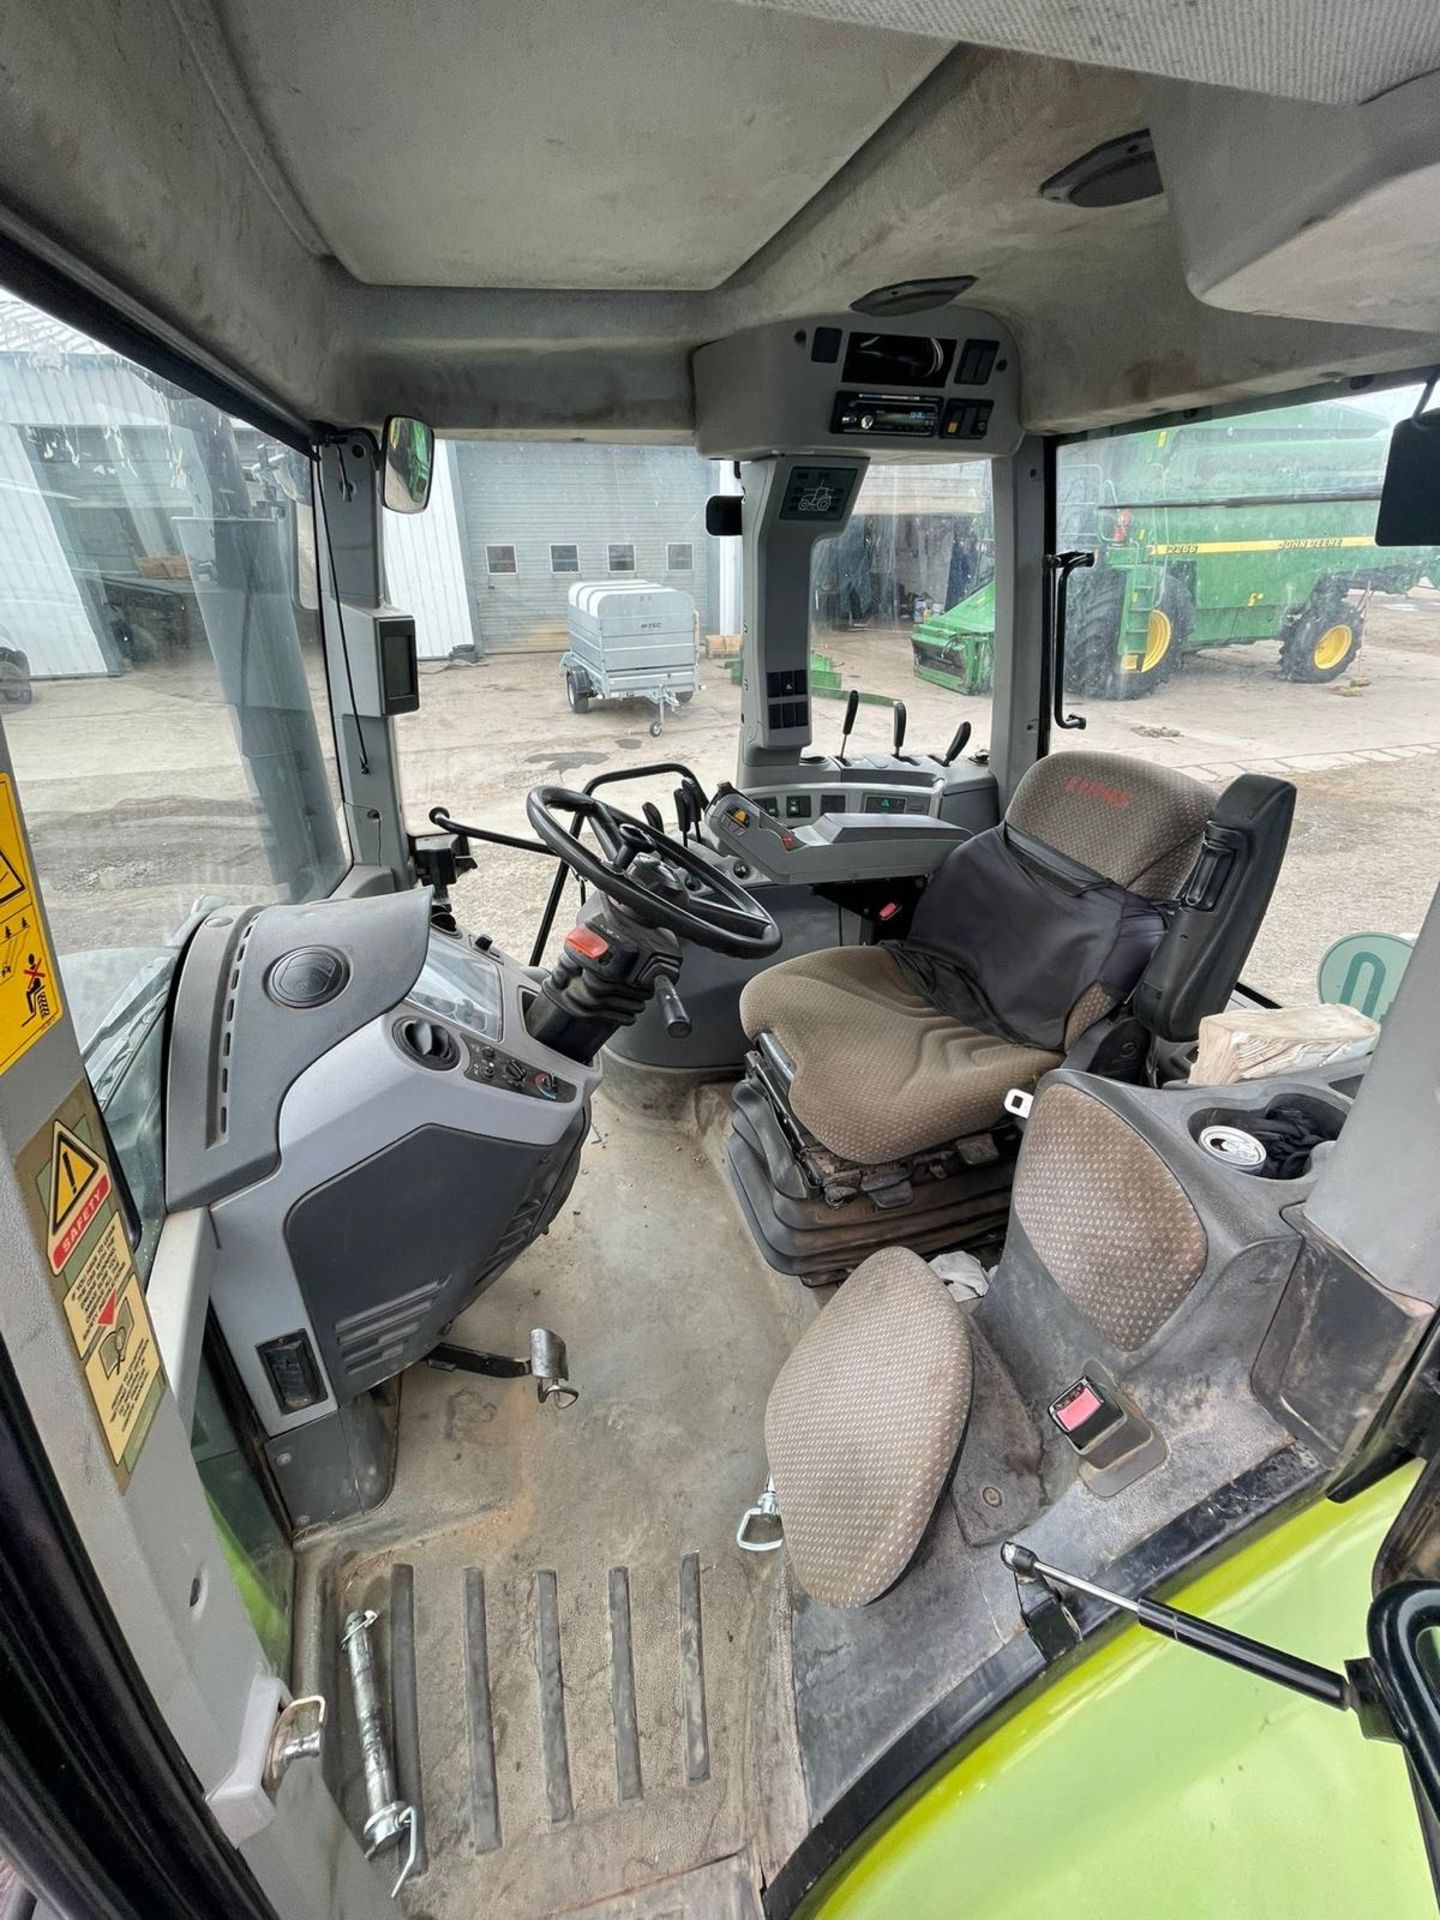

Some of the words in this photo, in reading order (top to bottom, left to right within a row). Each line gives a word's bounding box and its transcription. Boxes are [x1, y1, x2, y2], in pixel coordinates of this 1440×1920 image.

[1167, 544, 1198, 553] 2266
[1279, 539, 1308, 550] JOHN
[1309, 538, 1343, 549] DEERE
[60, 1187, 102, 1253] SAFETY
